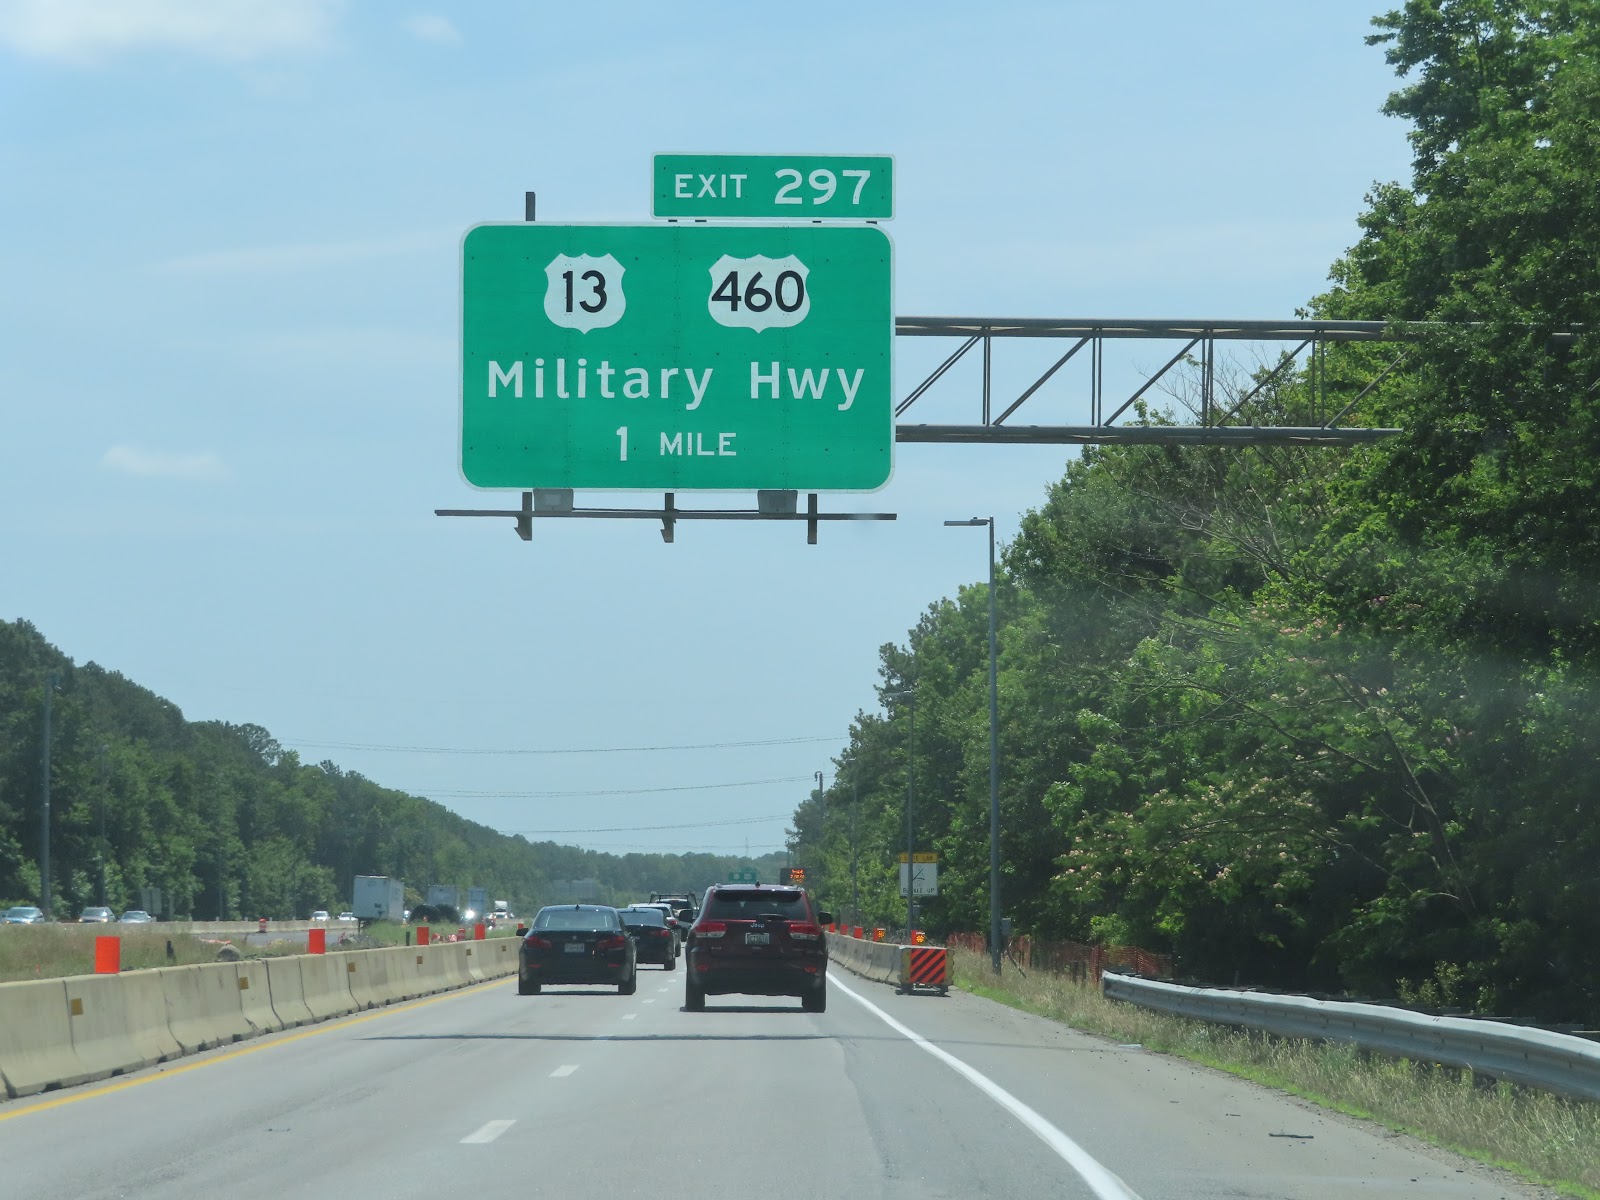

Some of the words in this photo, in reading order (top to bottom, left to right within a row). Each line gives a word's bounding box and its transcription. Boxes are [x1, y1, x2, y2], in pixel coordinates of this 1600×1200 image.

[675, 174, 748, 198] EXIT
[774, 169, 871, 205] 297
[562, 270, 607, 313] 13
[711, 270, 805, 313] 460
[488, 358, 713, 410] Military
[750, 361, 865, 411] Hwy
[616, 426, 628, 462] 1
[660, 432, 737, 456] MILE
